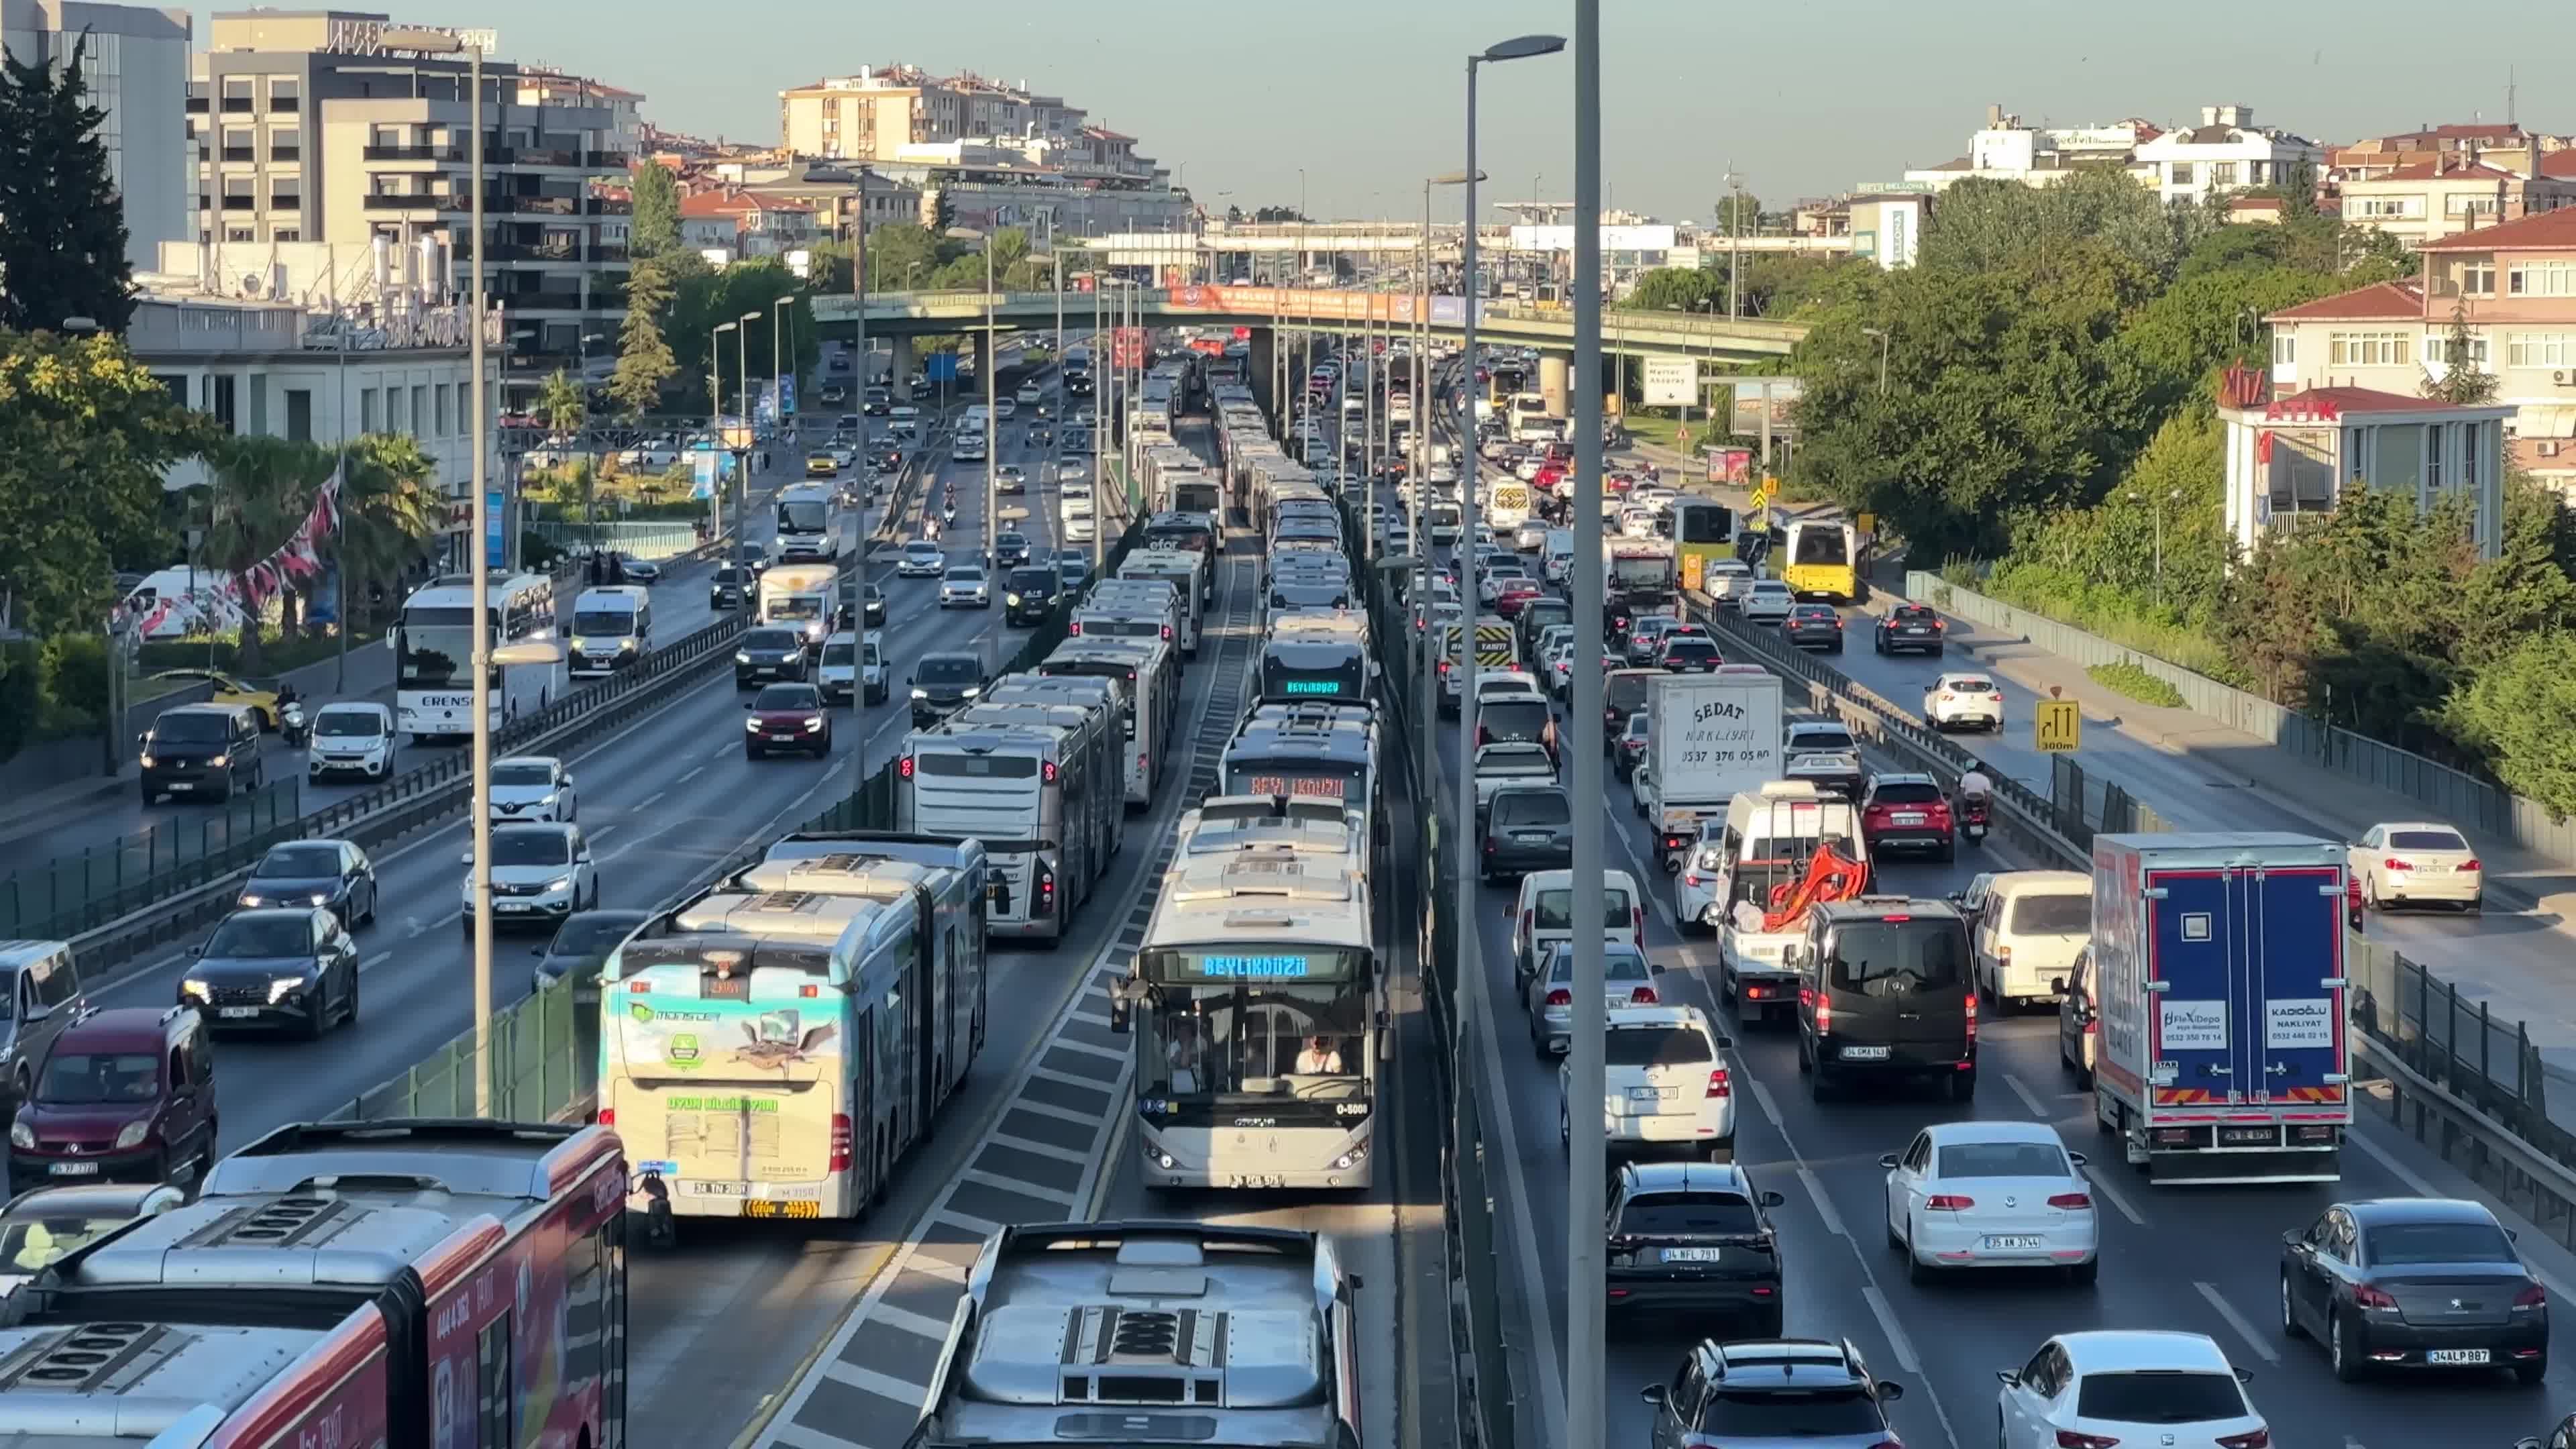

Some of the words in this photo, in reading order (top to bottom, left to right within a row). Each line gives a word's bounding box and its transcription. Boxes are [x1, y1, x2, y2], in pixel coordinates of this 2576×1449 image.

[1893, 215, 1903, 260] ELLONA
[1695, 702, 1744, 722] SEDAT
[1205, 957, 1307, 977] BEYLİKDÜZÜ
[2018, 1238, 2038, 1246] 3744
[1666, 1250, 1676, 1260] 34
[1680, 1250, 1697, 1260] NFL
[1701, 1249, 1716, 1260] 791
